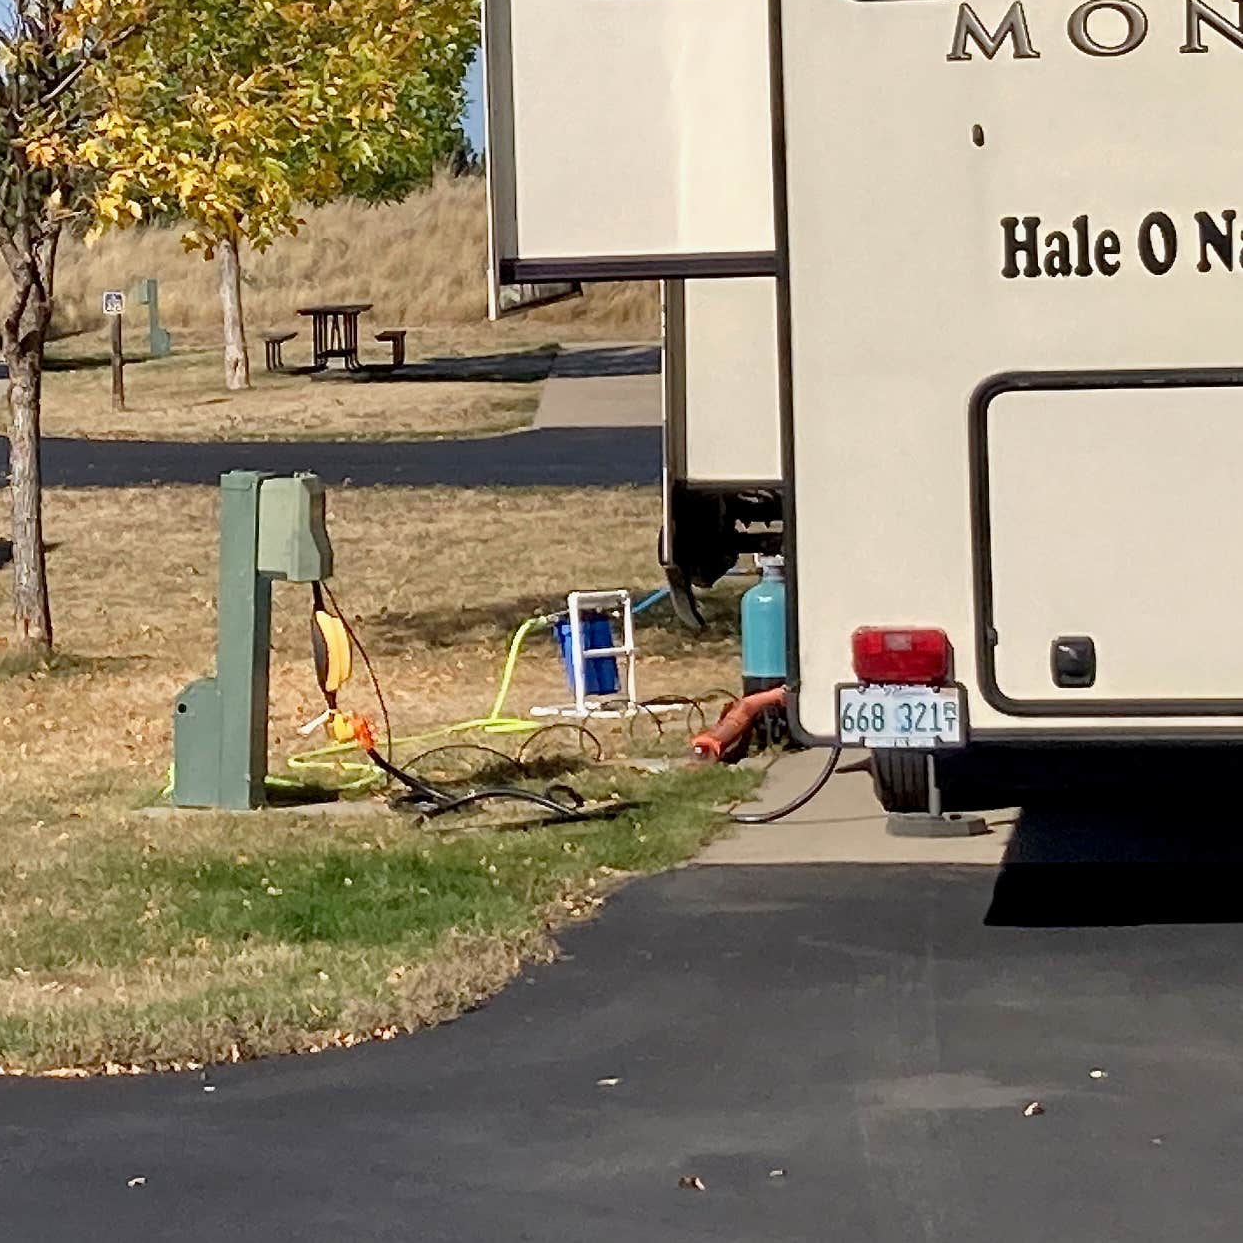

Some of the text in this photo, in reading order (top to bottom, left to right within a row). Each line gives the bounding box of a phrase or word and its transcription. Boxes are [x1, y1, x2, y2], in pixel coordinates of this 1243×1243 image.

[1000, 209, 1243, 279] Hale O N
[842, 702, 885, 732] 668
[897, 702, 942, 732] 321
